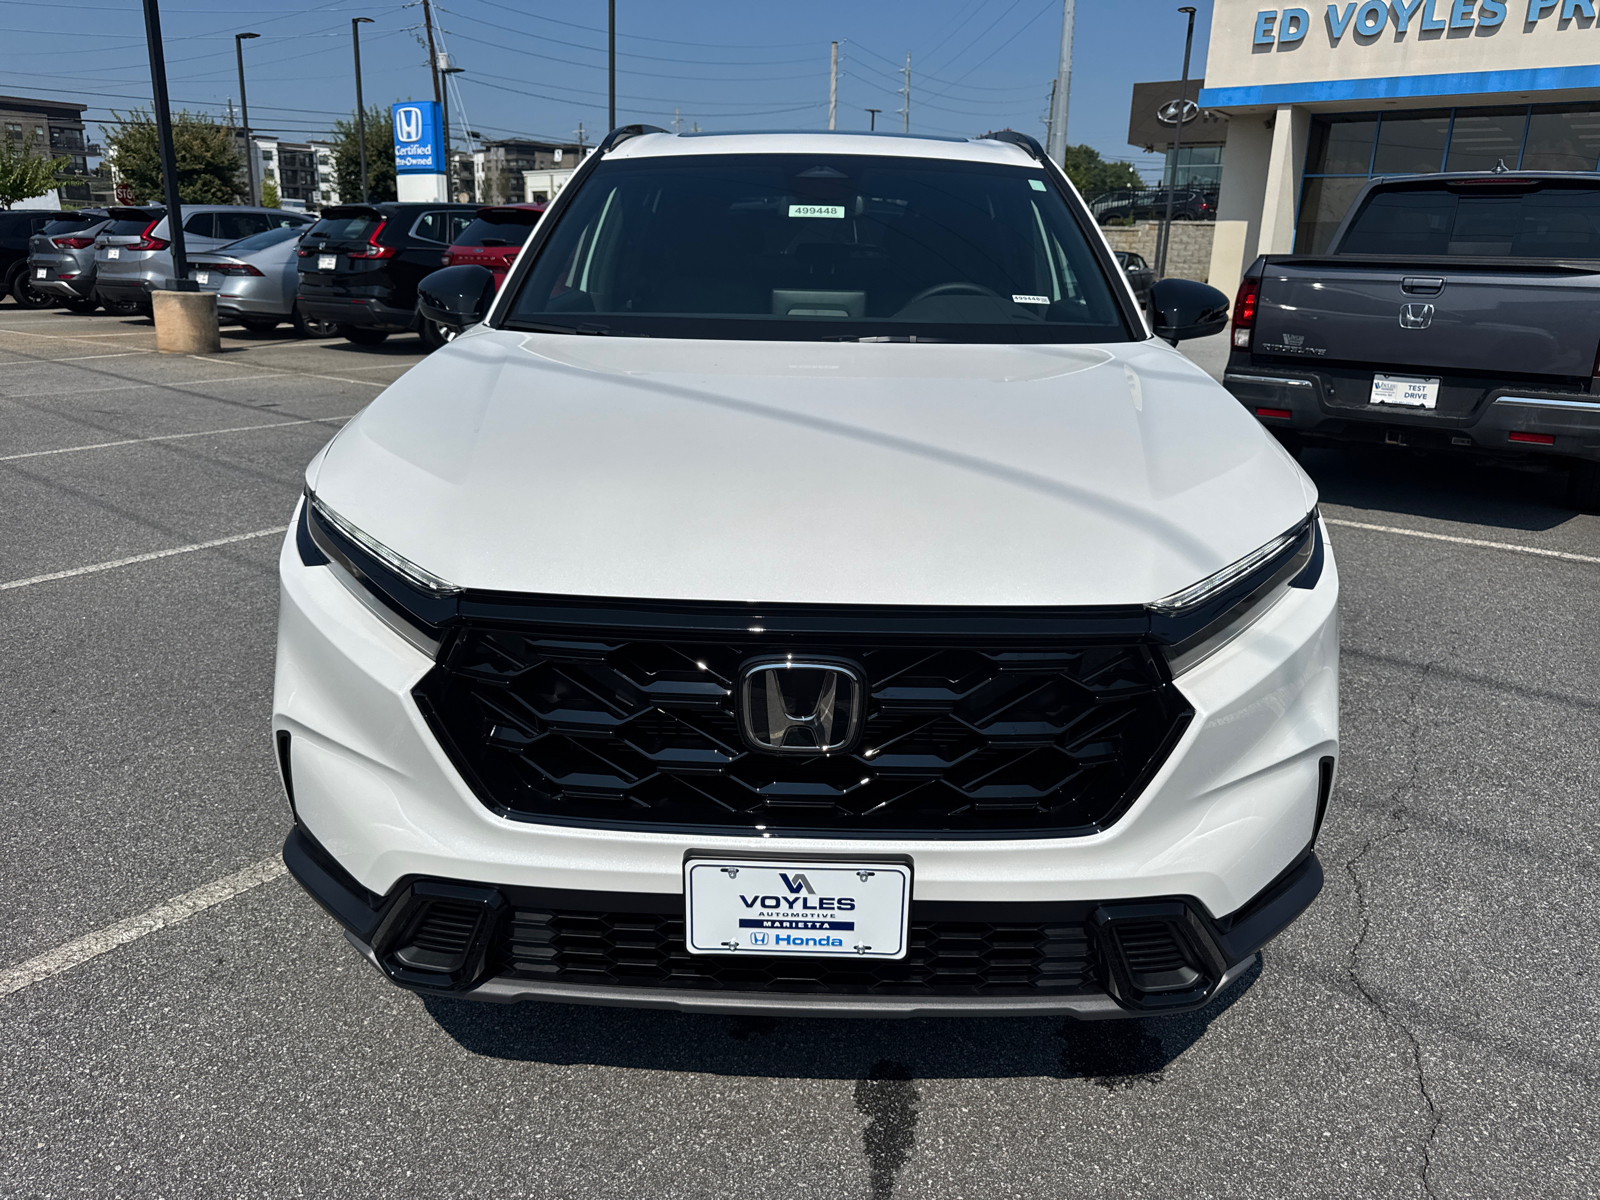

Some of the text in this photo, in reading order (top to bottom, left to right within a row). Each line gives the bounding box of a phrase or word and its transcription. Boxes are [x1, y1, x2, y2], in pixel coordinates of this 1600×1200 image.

[1254, 8, 1309, 44] ED
[1327, 0, 1507, 38] VOYLES
[395, 144, 431, 156] Certified
[117, 188, 133, 199] STO
[739, 895, 855, 910] VOYLES
[763, 921, 830, 929] MARIETTA
[775, 934, 843, 946] Honda
